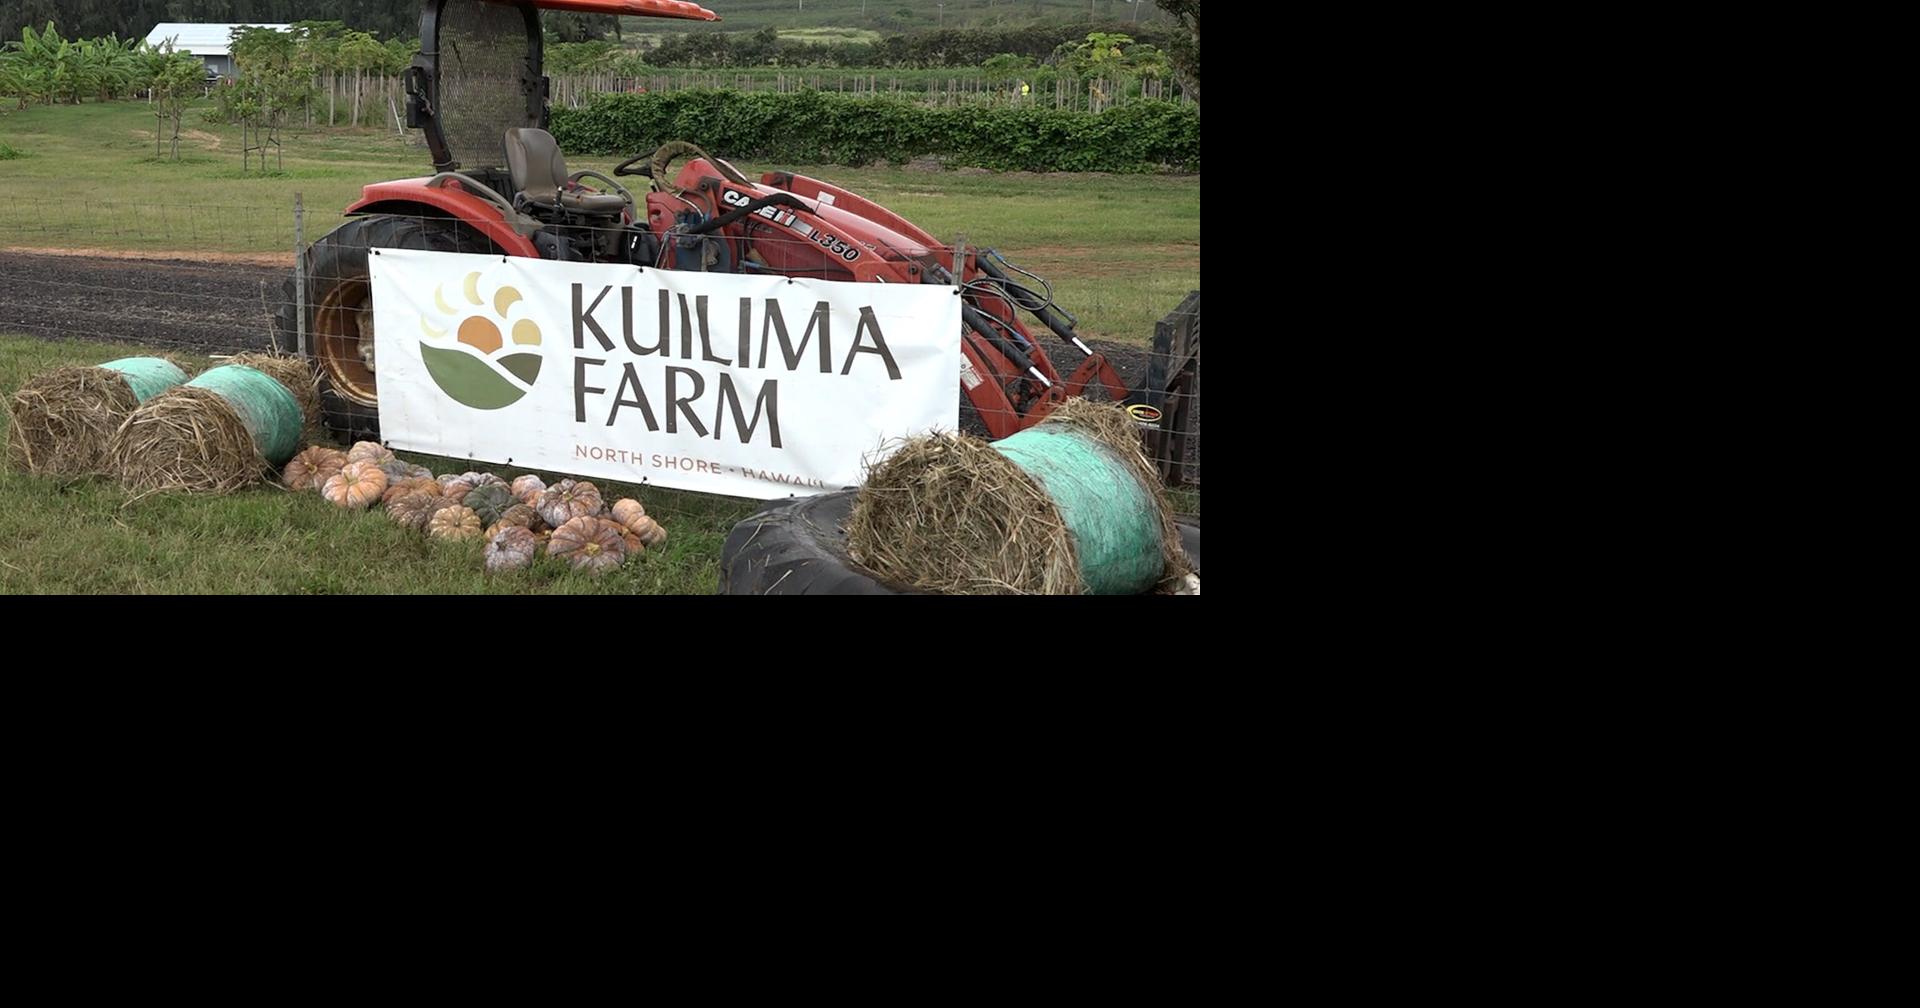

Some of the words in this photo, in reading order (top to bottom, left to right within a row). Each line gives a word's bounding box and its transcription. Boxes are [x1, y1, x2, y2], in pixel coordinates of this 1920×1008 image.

[724, 190, 778, 219] CAE
[809, 229, 860, 263] L350
[571, 282, 902, 380] KUILIMA
[574, 356, 782, 449] FARM
[575, 444, 643, 466] NORTH
[651, 454, 722, 475] SHORE
